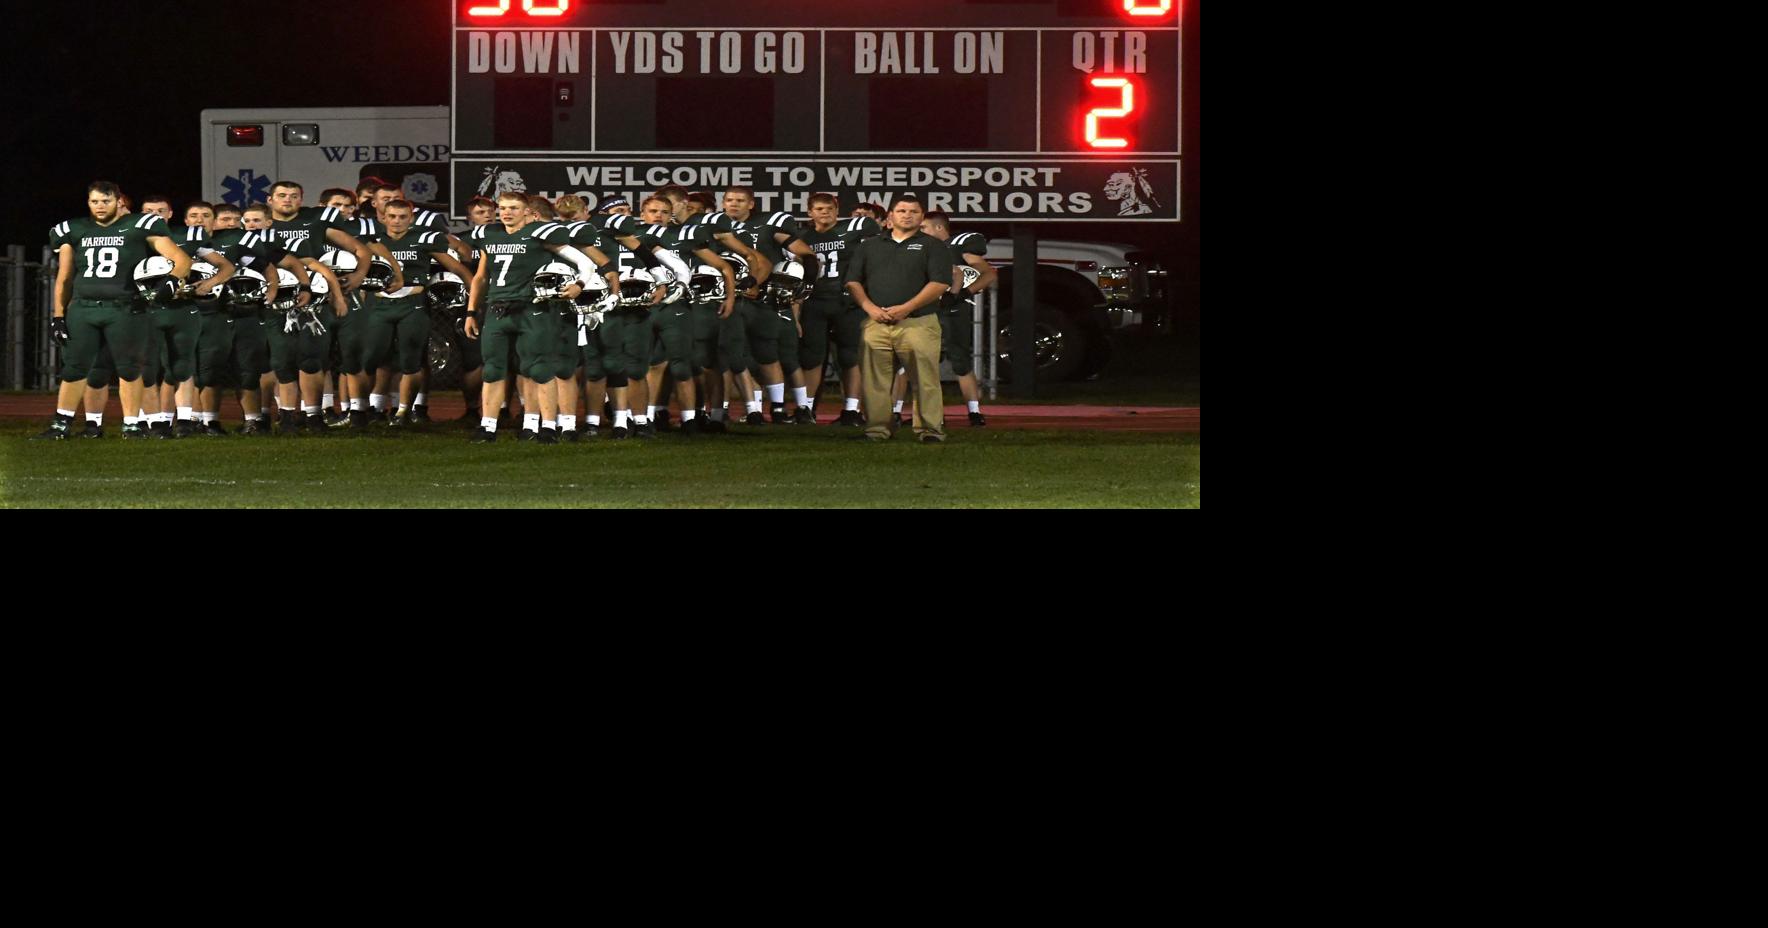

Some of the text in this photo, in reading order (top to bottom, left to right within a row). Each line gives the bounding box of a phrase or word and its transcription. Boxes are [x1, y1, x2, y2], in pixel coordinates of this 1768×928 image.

[468, 31, 580, 74] DOWN
[609, 31, 805, 74] YDS TO GO
[854, 31, 1004, 74] BALL ON
[1072, 31, 1147, 74] QTR
[1085, 78, 1133, 148] 2
[566, 166, 1061, 187] WELCOME TO WEEDSPORT
[754, 191, 839, 213] TH
[856, 191, 1093, 214] WRRIORS
[82, 236, 125, 247] WARRIORS
[485, 244, 527, 254] WARRIORS
[83, 247, 120, 278] 18
[494, 254, 514, 287] 7
